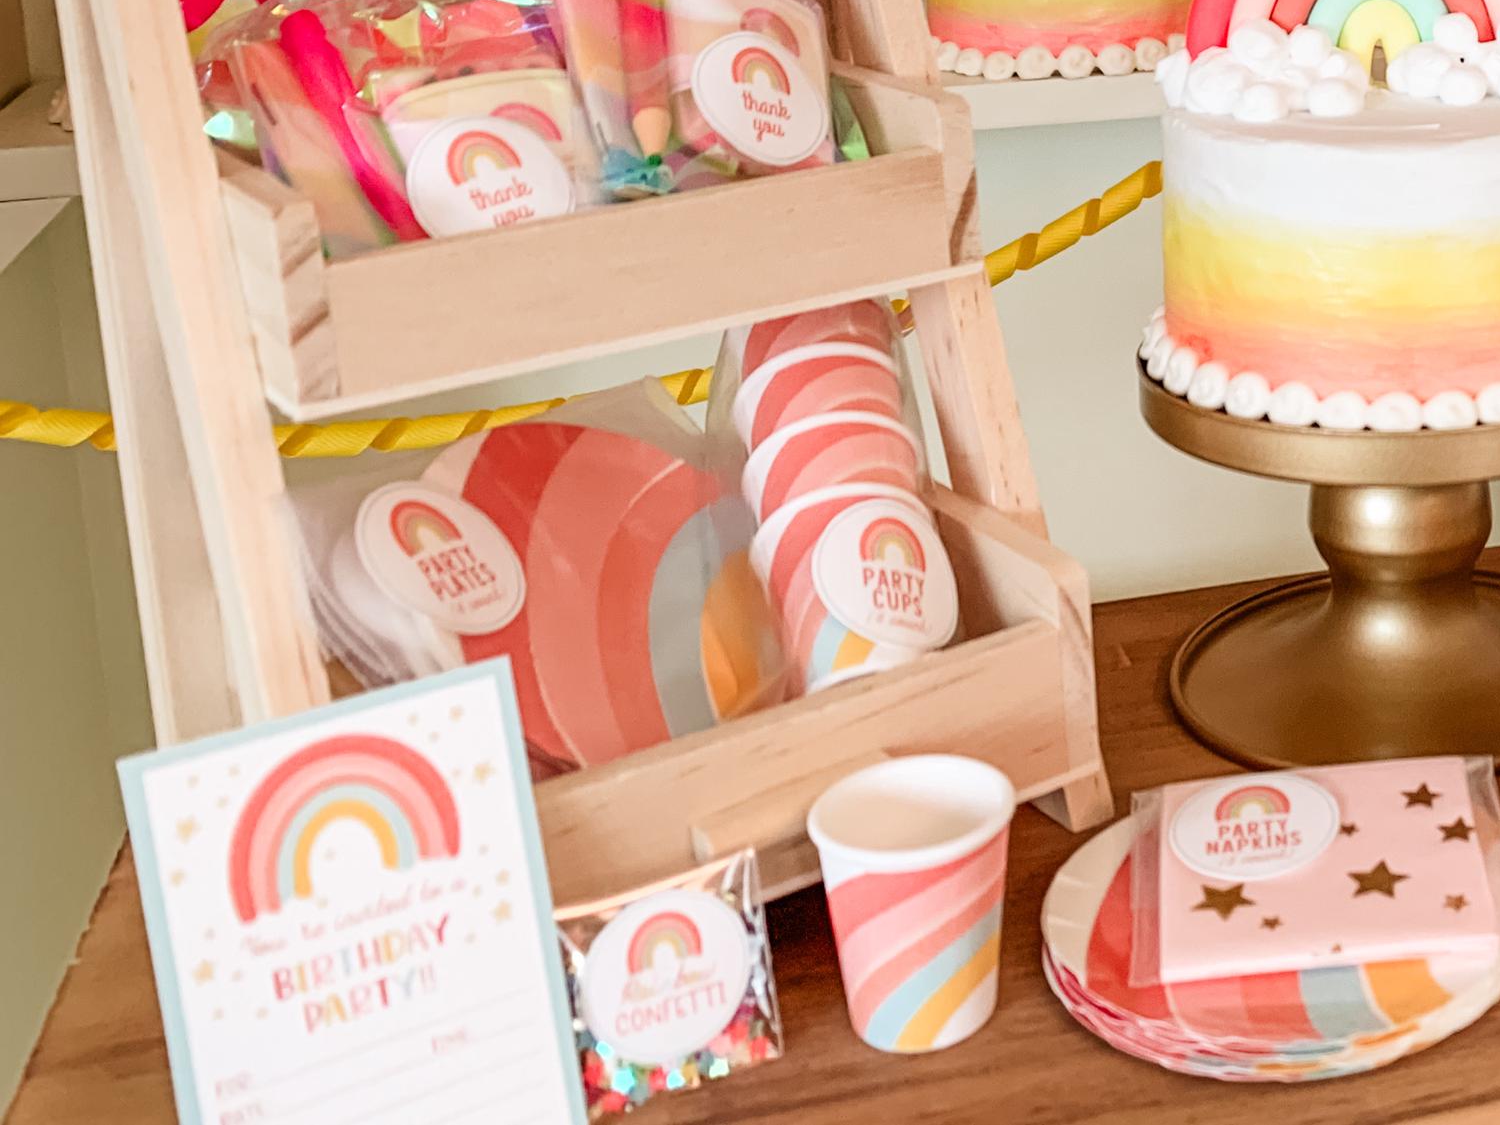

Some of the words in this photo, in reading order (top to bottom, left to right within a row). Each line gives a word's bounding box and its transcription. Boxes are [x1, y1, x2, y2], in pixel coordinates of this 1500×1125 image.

[741, 89, 792, 120] thank
[752, 117, 785, 142] you
[469, 175, 534, 211] thank
[418, 544, 477, 579] PARTY
[430, 562, 497, 602] PLATES
[862, 567, 925, 597] PARTY
[872, 587, 923, 618] CUPS
[1206, 830, 1303, 856] NAPKINS
[1218, 819, 1287, 840] PARTY
[271, 912, 450, 1002] BIRTHDAY
[615, 979, 727, 1038] CONFETTI
